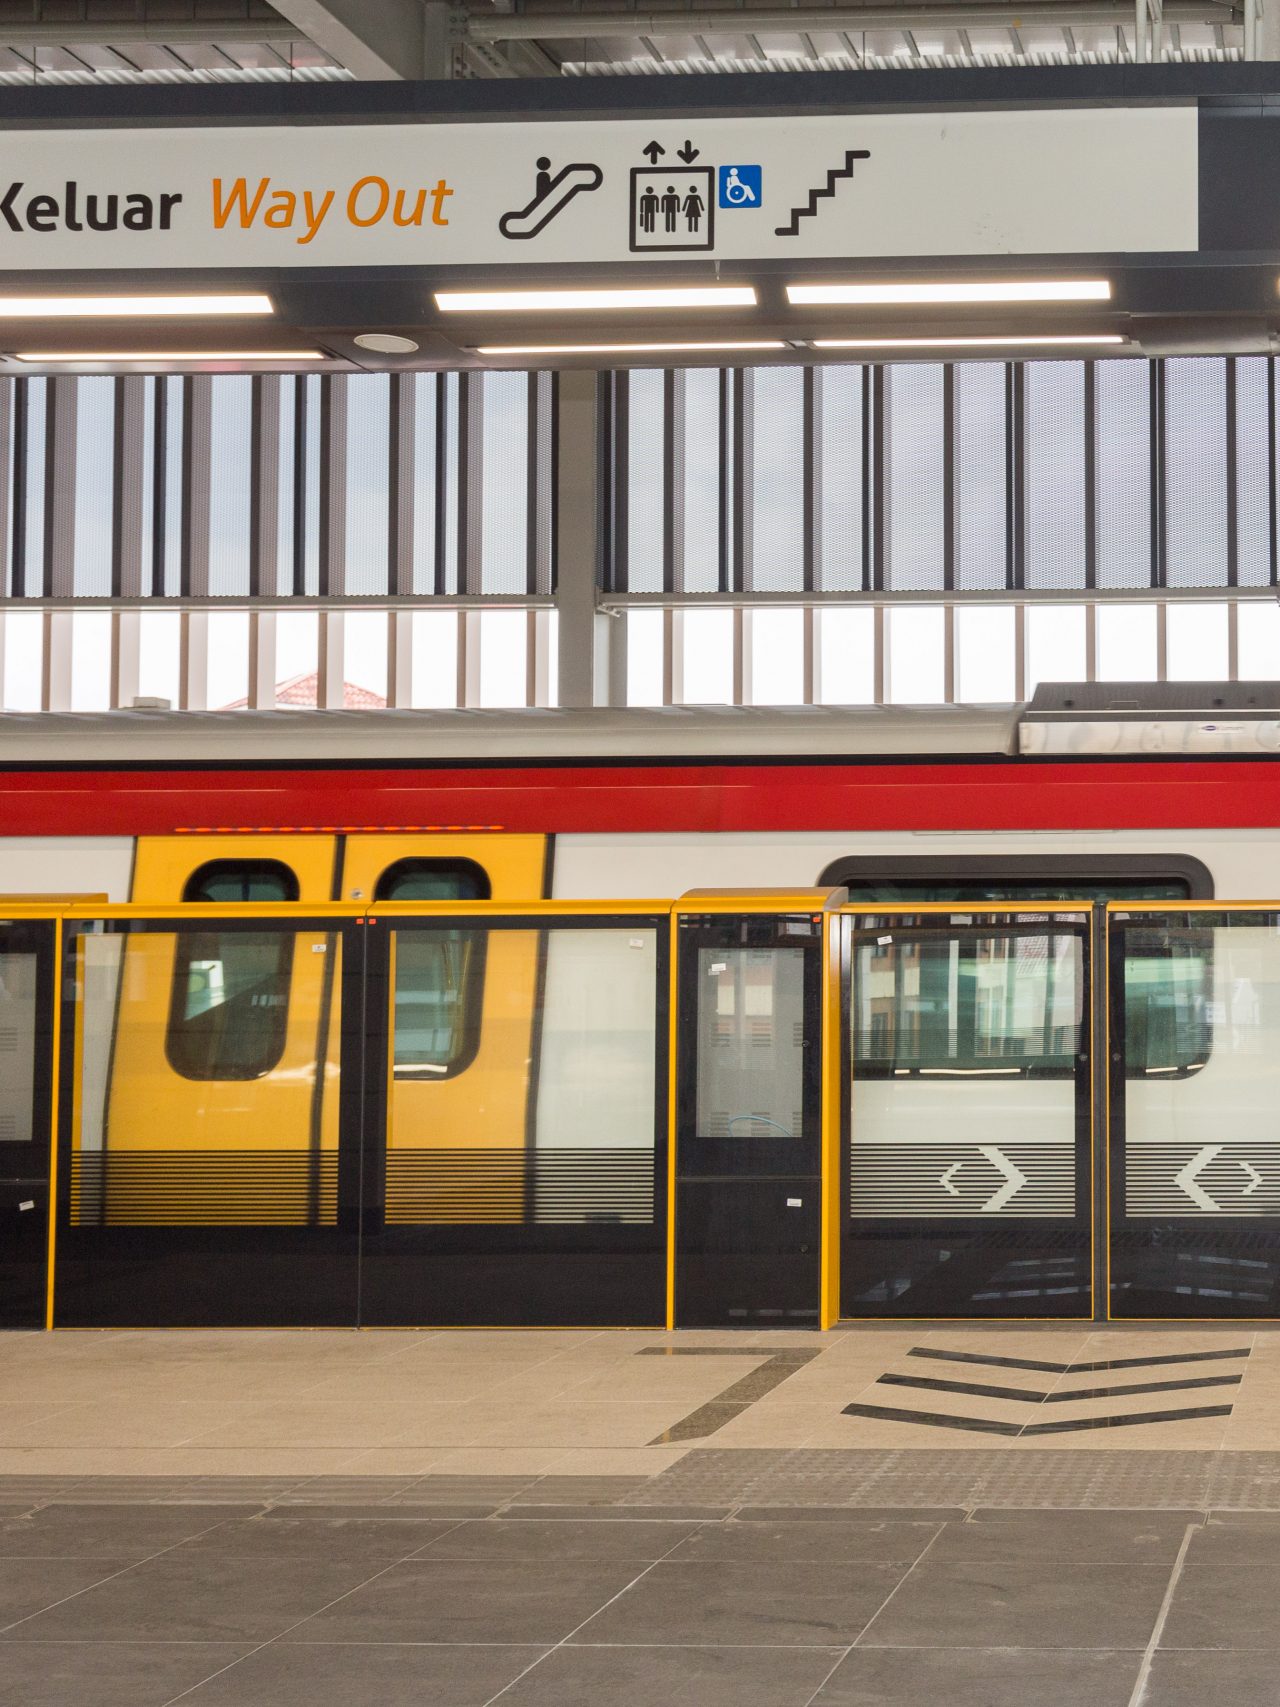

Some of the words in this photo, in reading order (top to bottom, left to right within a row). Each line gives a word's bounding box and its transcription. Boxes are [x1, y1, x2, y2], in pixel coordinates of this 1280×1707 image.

[0, 181, 183, 233] Keluar
[212, 177, 336, 245] Way
[346, 175, 454, 228] Out
